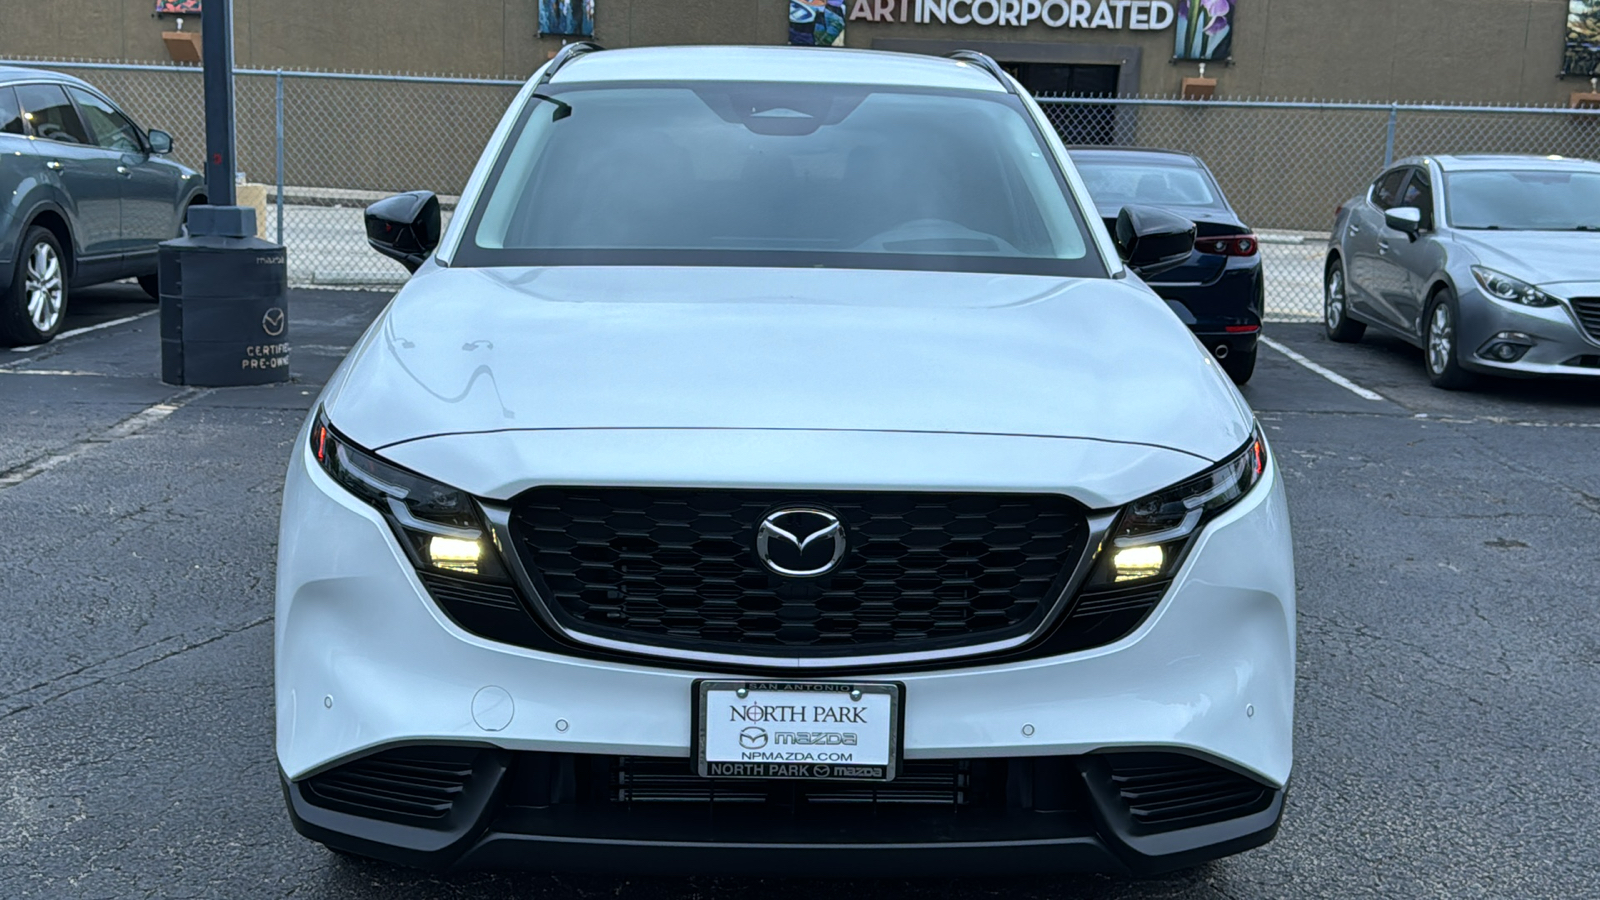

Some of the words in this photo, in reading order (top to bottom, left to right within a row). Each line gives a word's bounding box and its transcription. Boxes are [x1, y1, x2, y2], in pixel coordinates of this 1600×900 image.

[729, 705, 806, 722] NORTH
[813, 706, 868, 723] PARK
[774, 731, 858, 746] mazda
[741, 752, 853, 762] NPMAZDA.COM
[711, 763, 764, 775] NORTH
[769, 765, 809, 776] PARK
[833, 766, 883, 777] mazda
